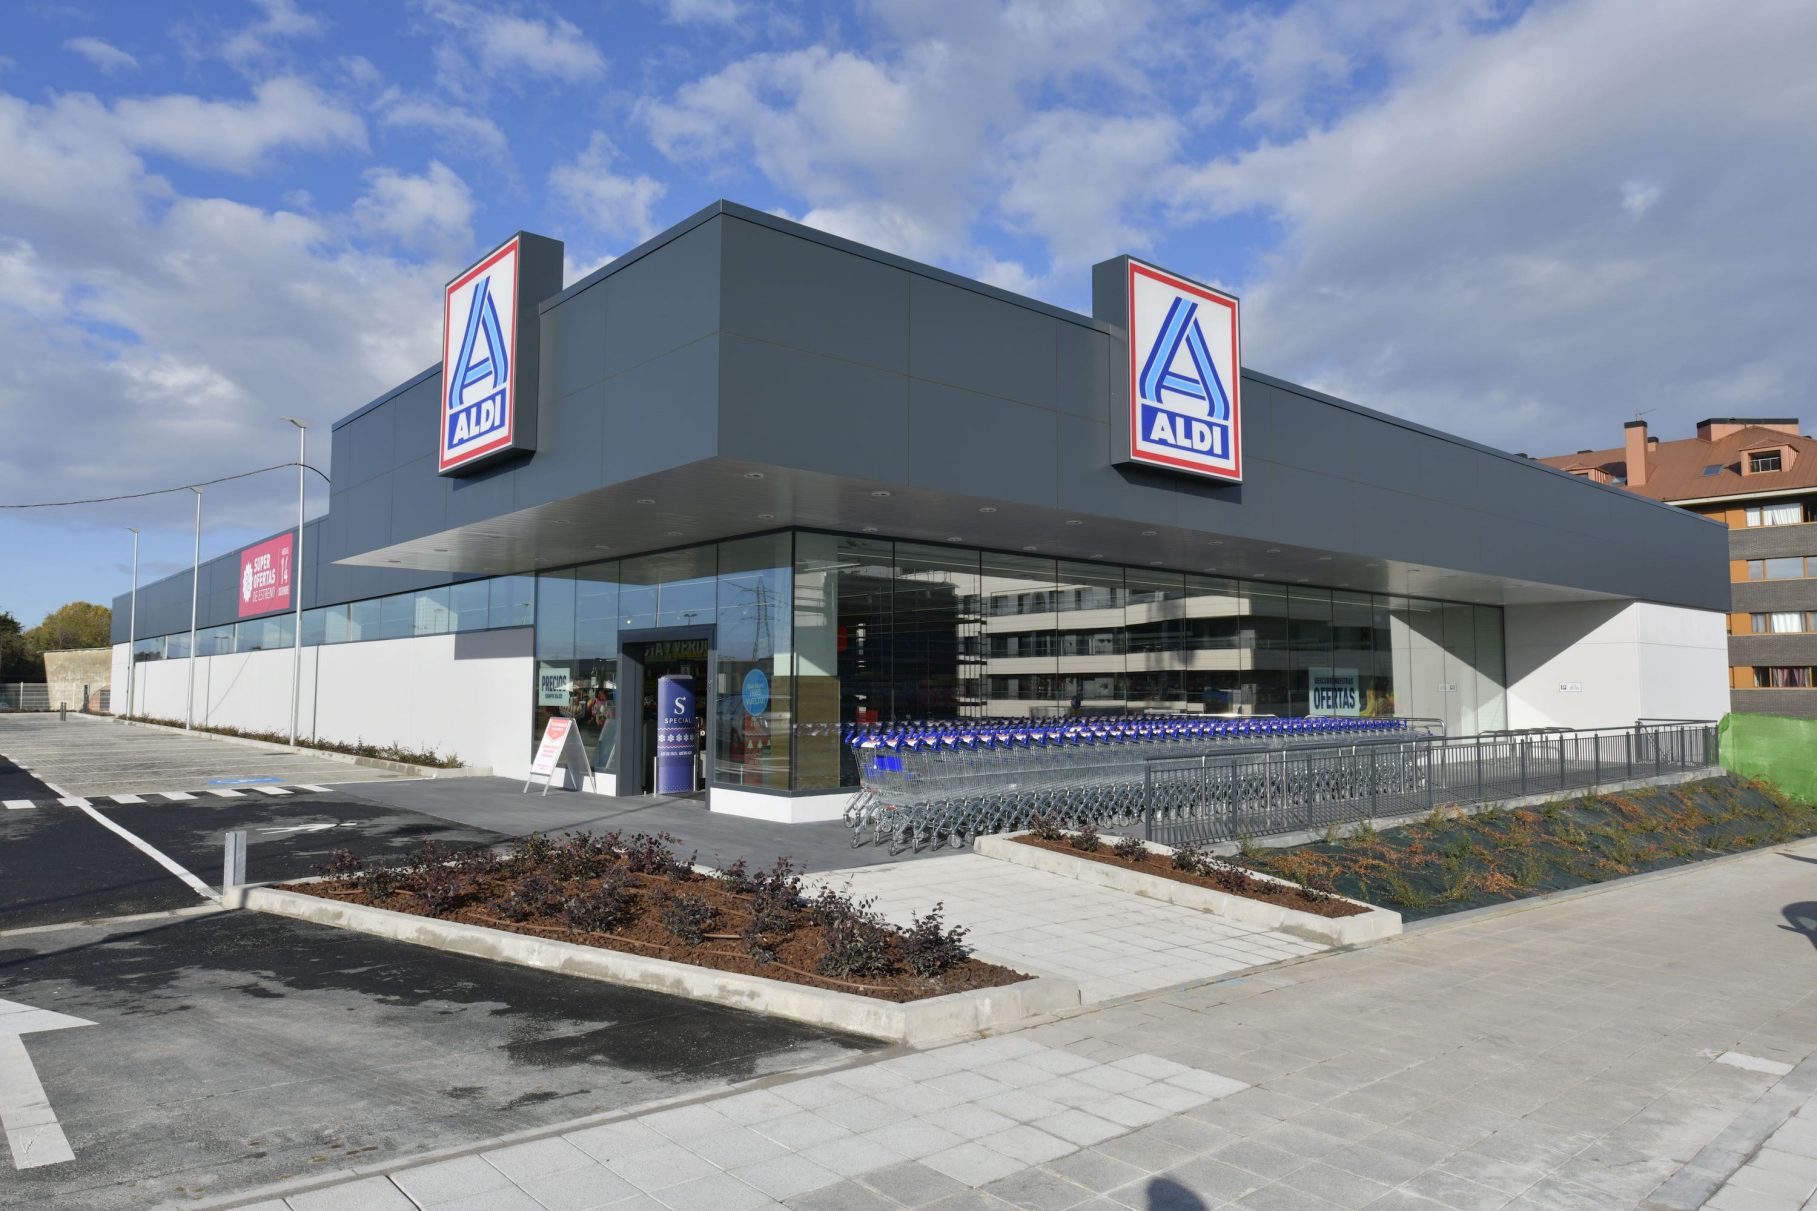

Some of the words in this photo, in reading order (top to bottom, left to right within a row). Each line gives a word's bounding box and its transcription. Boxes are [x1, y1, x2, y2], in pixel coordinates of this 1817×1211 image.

[453, 393, 502, 445] ALDI
[1150, 411, 1223, 456] ALDI
[254, 553, 271, 573] SUPER
[281, 556, 289, 585] 14
[253, 568, 276, 588] OFERTAS
[542, 675, 567, 692] PRECIOS
[1313, 686, 1355, 710] OFERTAS
